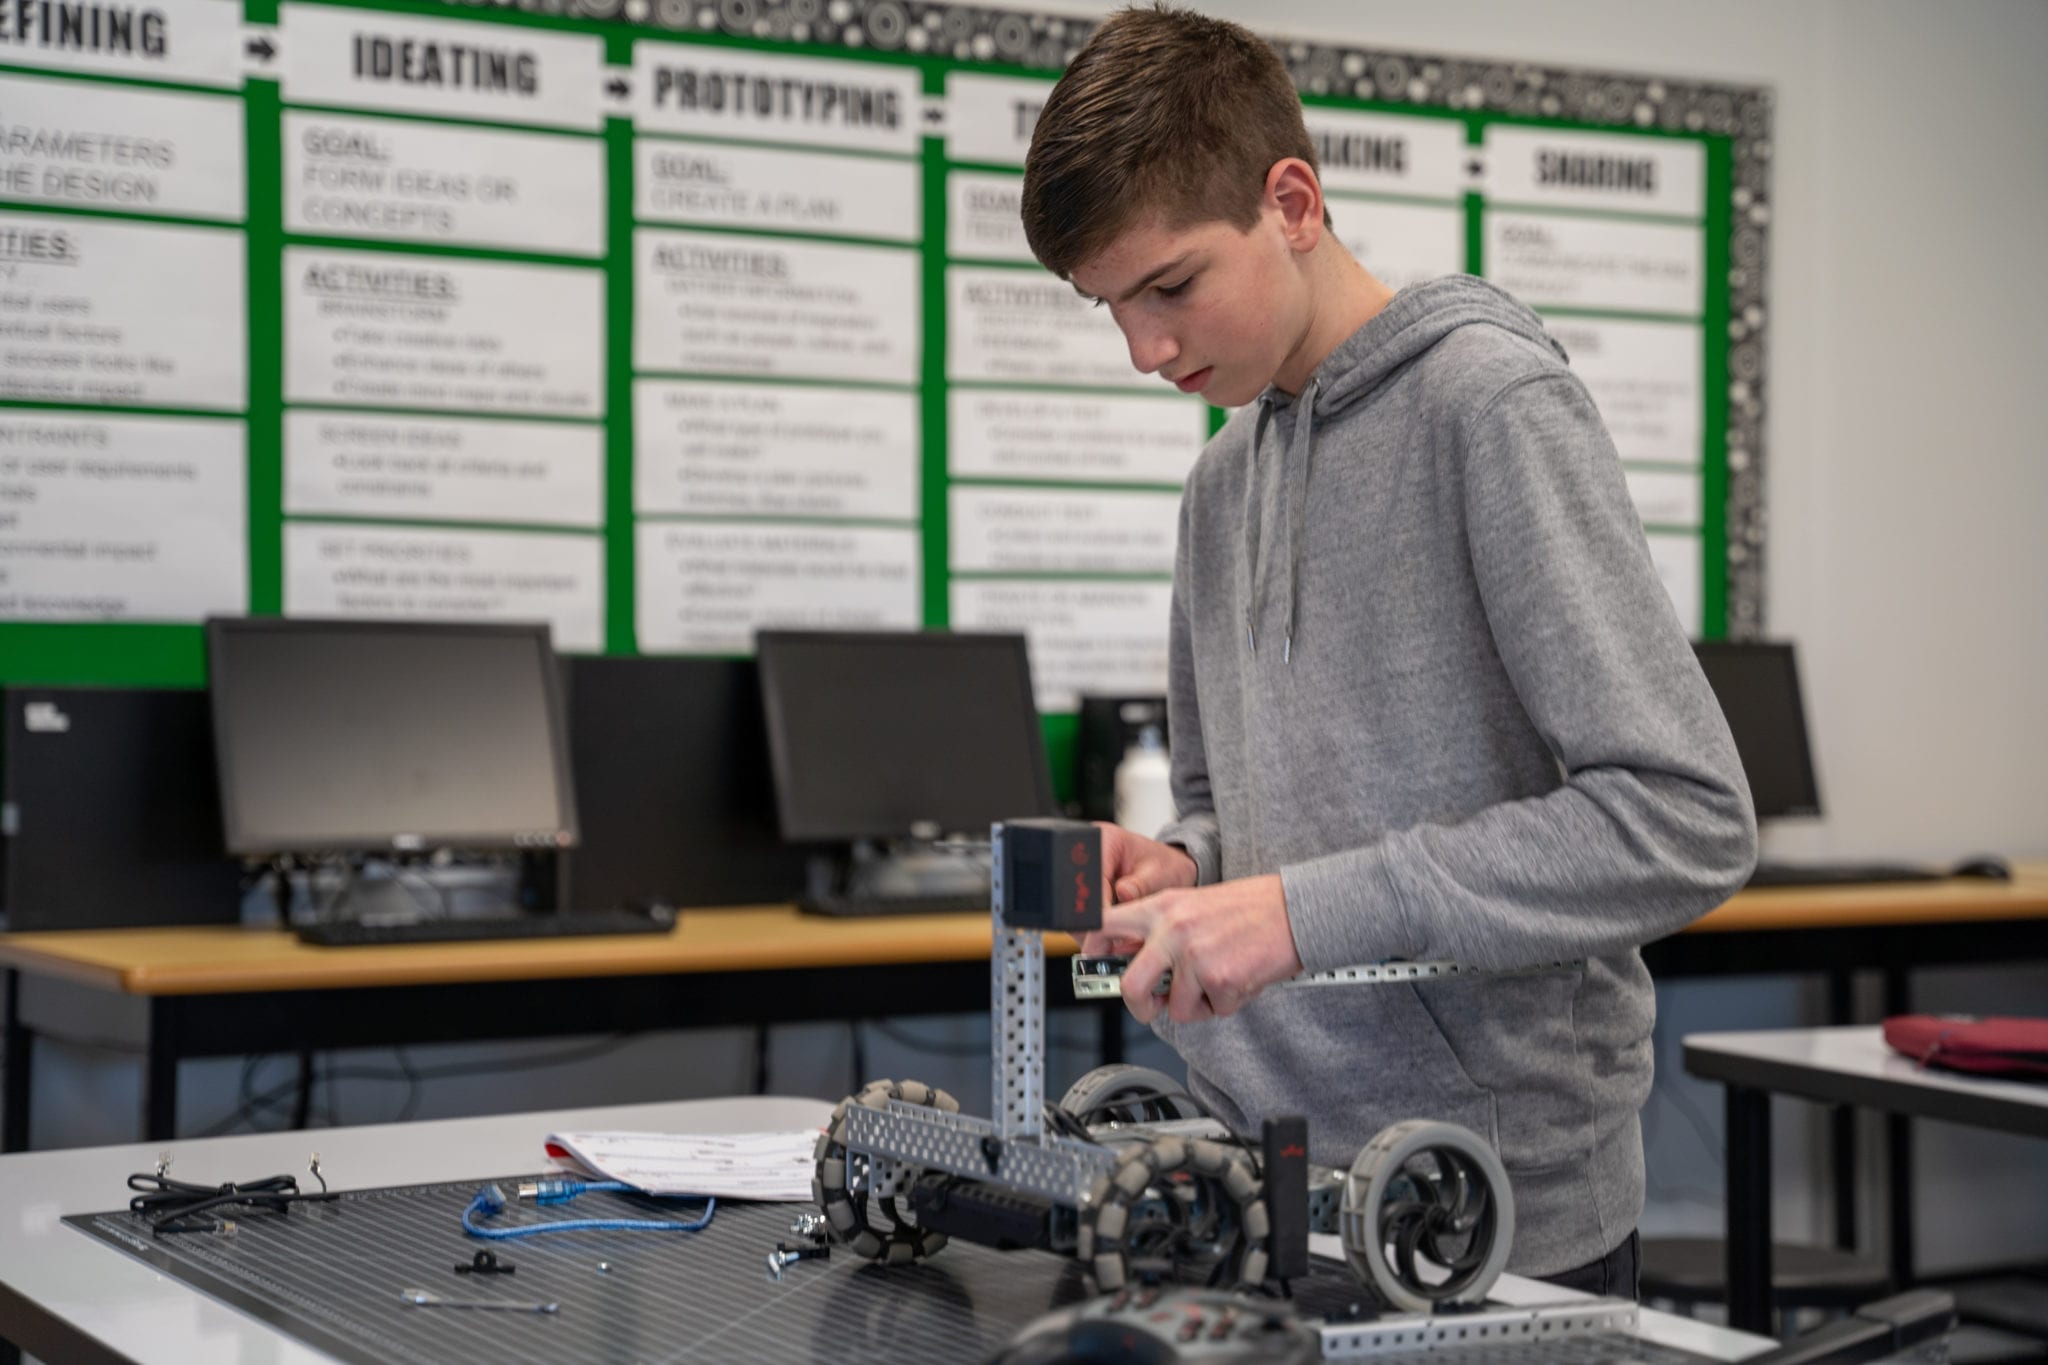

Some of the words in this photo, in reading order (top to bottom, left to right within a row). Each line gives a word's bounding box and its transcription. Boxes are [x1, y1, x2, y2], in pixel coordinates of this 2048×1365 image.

[350, 31, 541, 98] IDEATING
[652, 63, 902, 132] PROTOTYPING
[43, 166, 159, 203] DESIGN
[303, 161, 387, 193] FORM
[391, 169, 472, 201] IDEAS
[1534, 146, 1660, 196] SHARING
[303, 196, 457, 234] CONCEPTS
